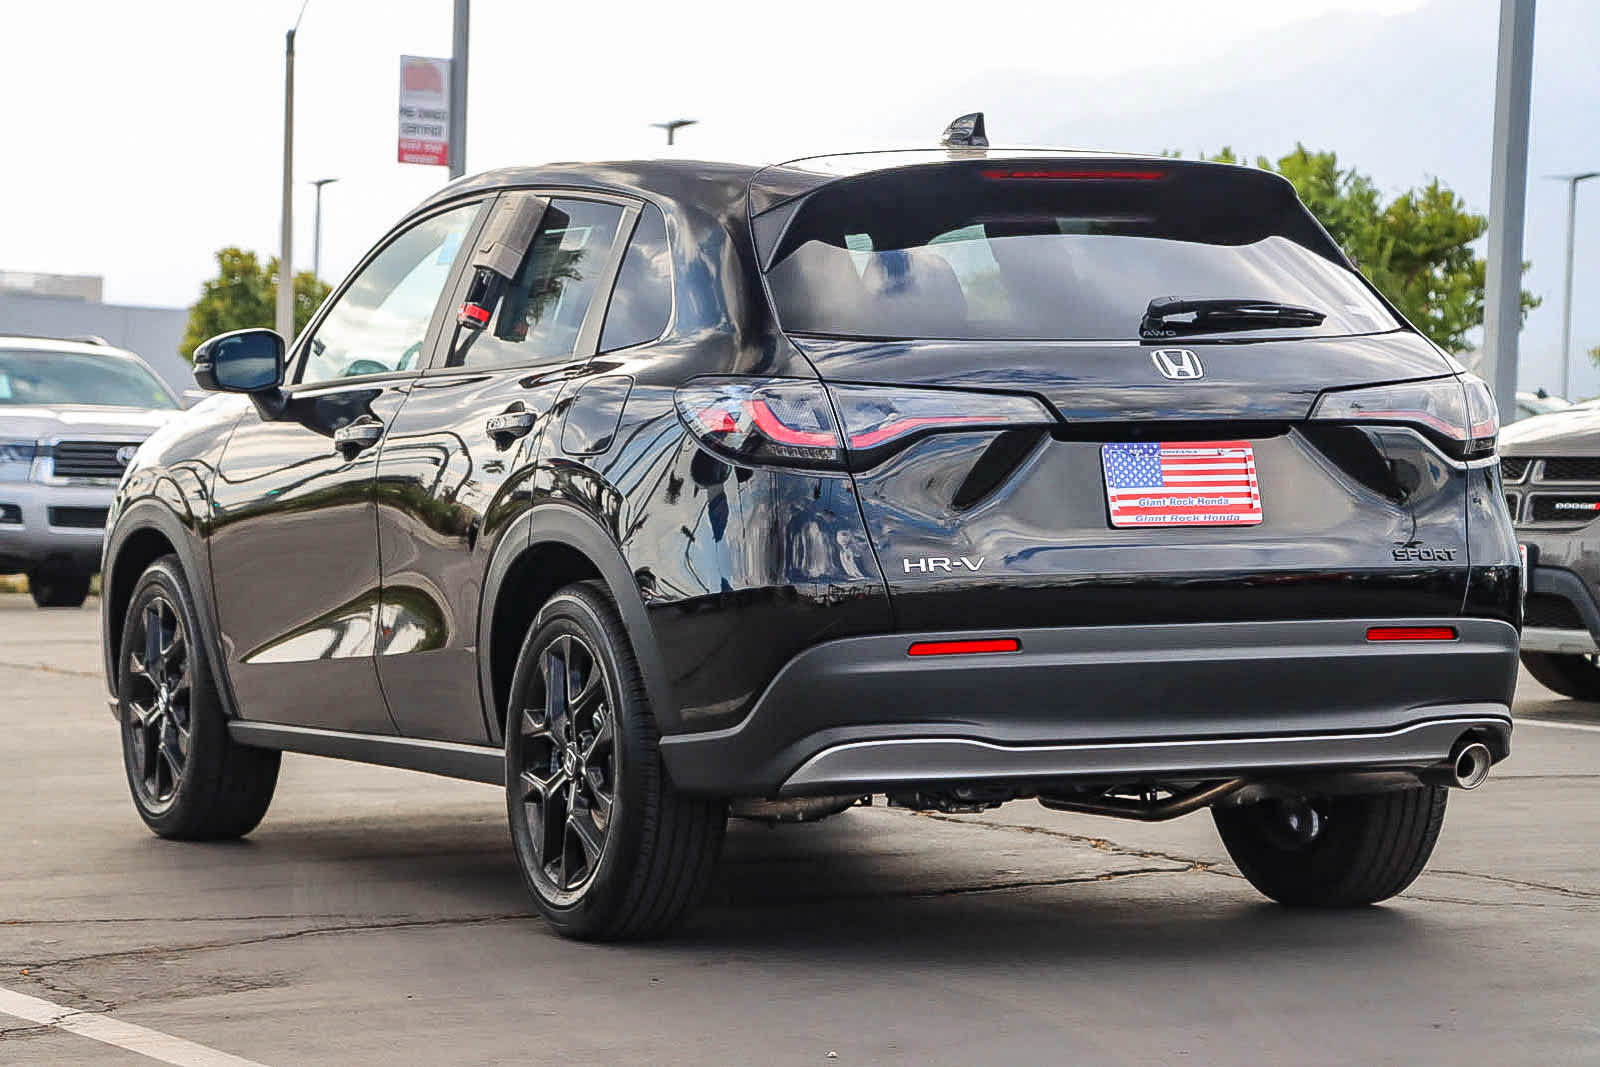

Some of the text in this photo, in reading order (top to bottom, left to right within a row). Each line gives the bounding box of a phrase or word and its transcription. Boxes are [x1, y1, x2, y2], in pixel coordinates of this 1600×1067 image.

[1138, 497, 1230, 507] Giant Rock Honda
[1392, 548, 1457, 561] SPORT
[903, 556, 985, 573] HR-V
